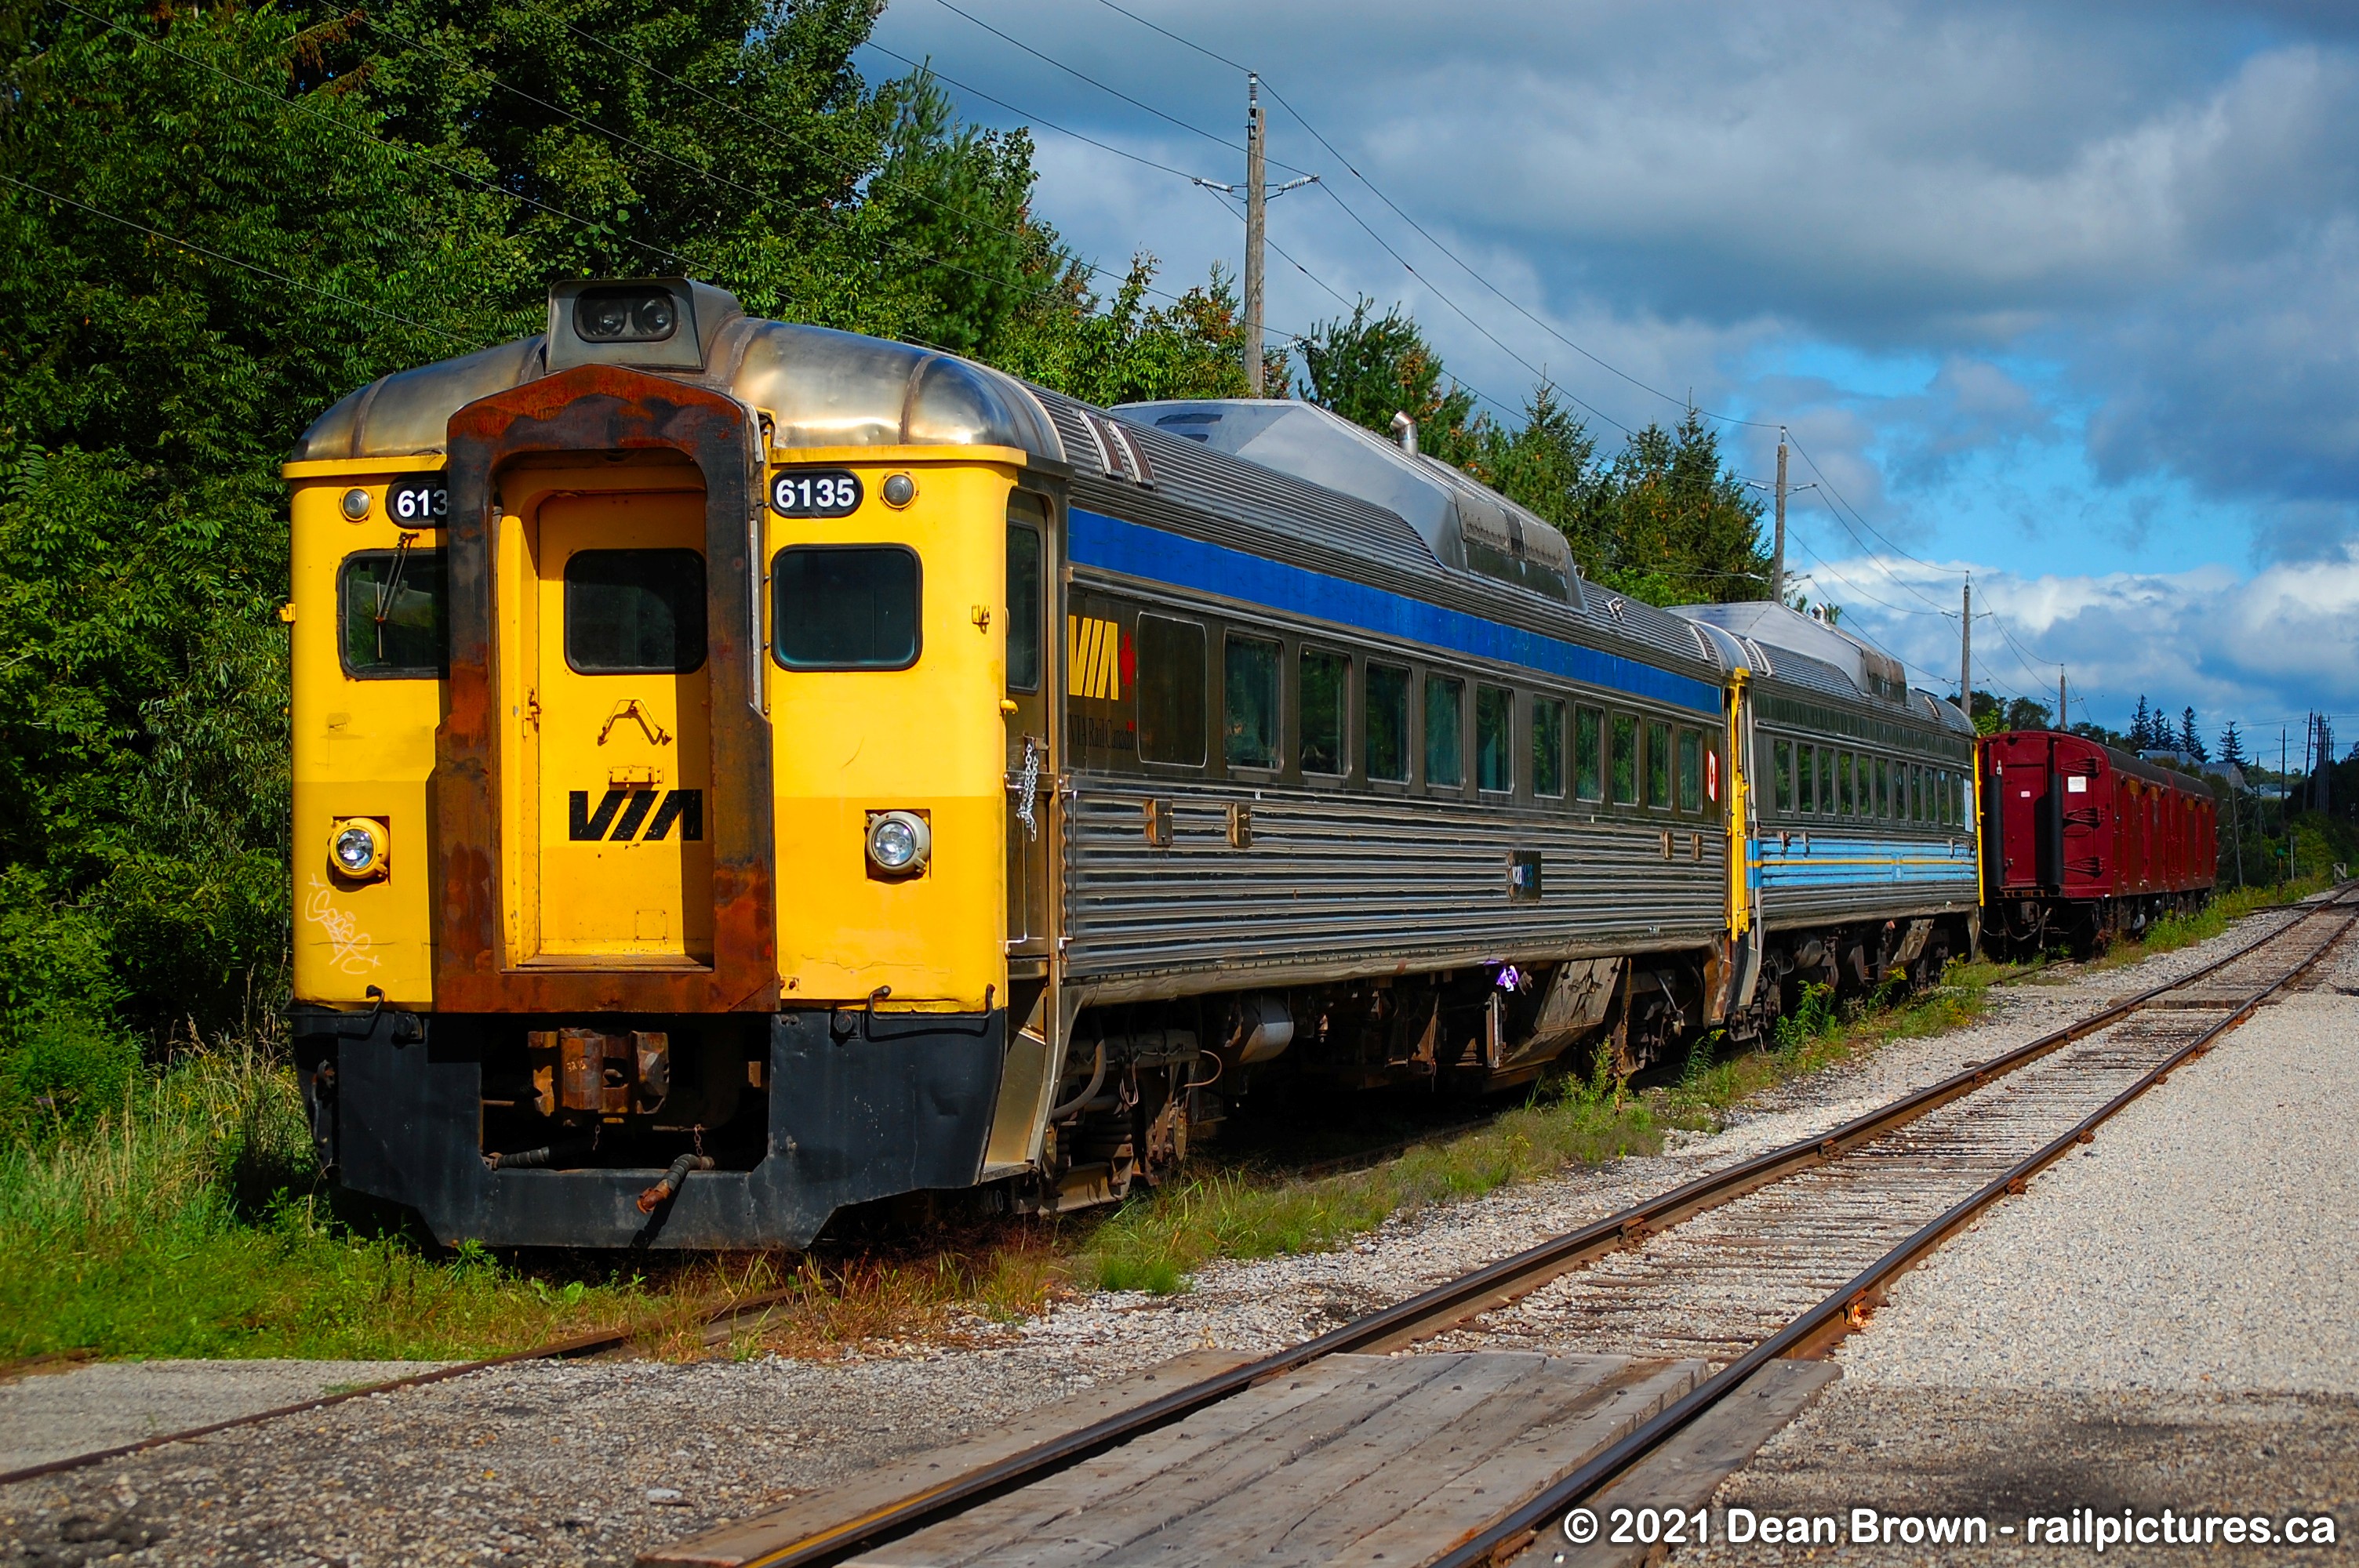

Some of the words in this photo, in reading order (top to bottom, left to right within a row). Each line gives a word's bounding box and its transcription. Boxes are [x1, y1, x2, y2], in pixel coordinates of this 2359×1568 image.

[397, 489, 448, 517] 613
[776, 478, 855, 508] 6135
[1068, 615, 1119, 701] VIA
[1068, 714, 1087, 747] VIA
[1089, 717, 1104, 749] Rail
[569, 789, 703, 841] VIA
